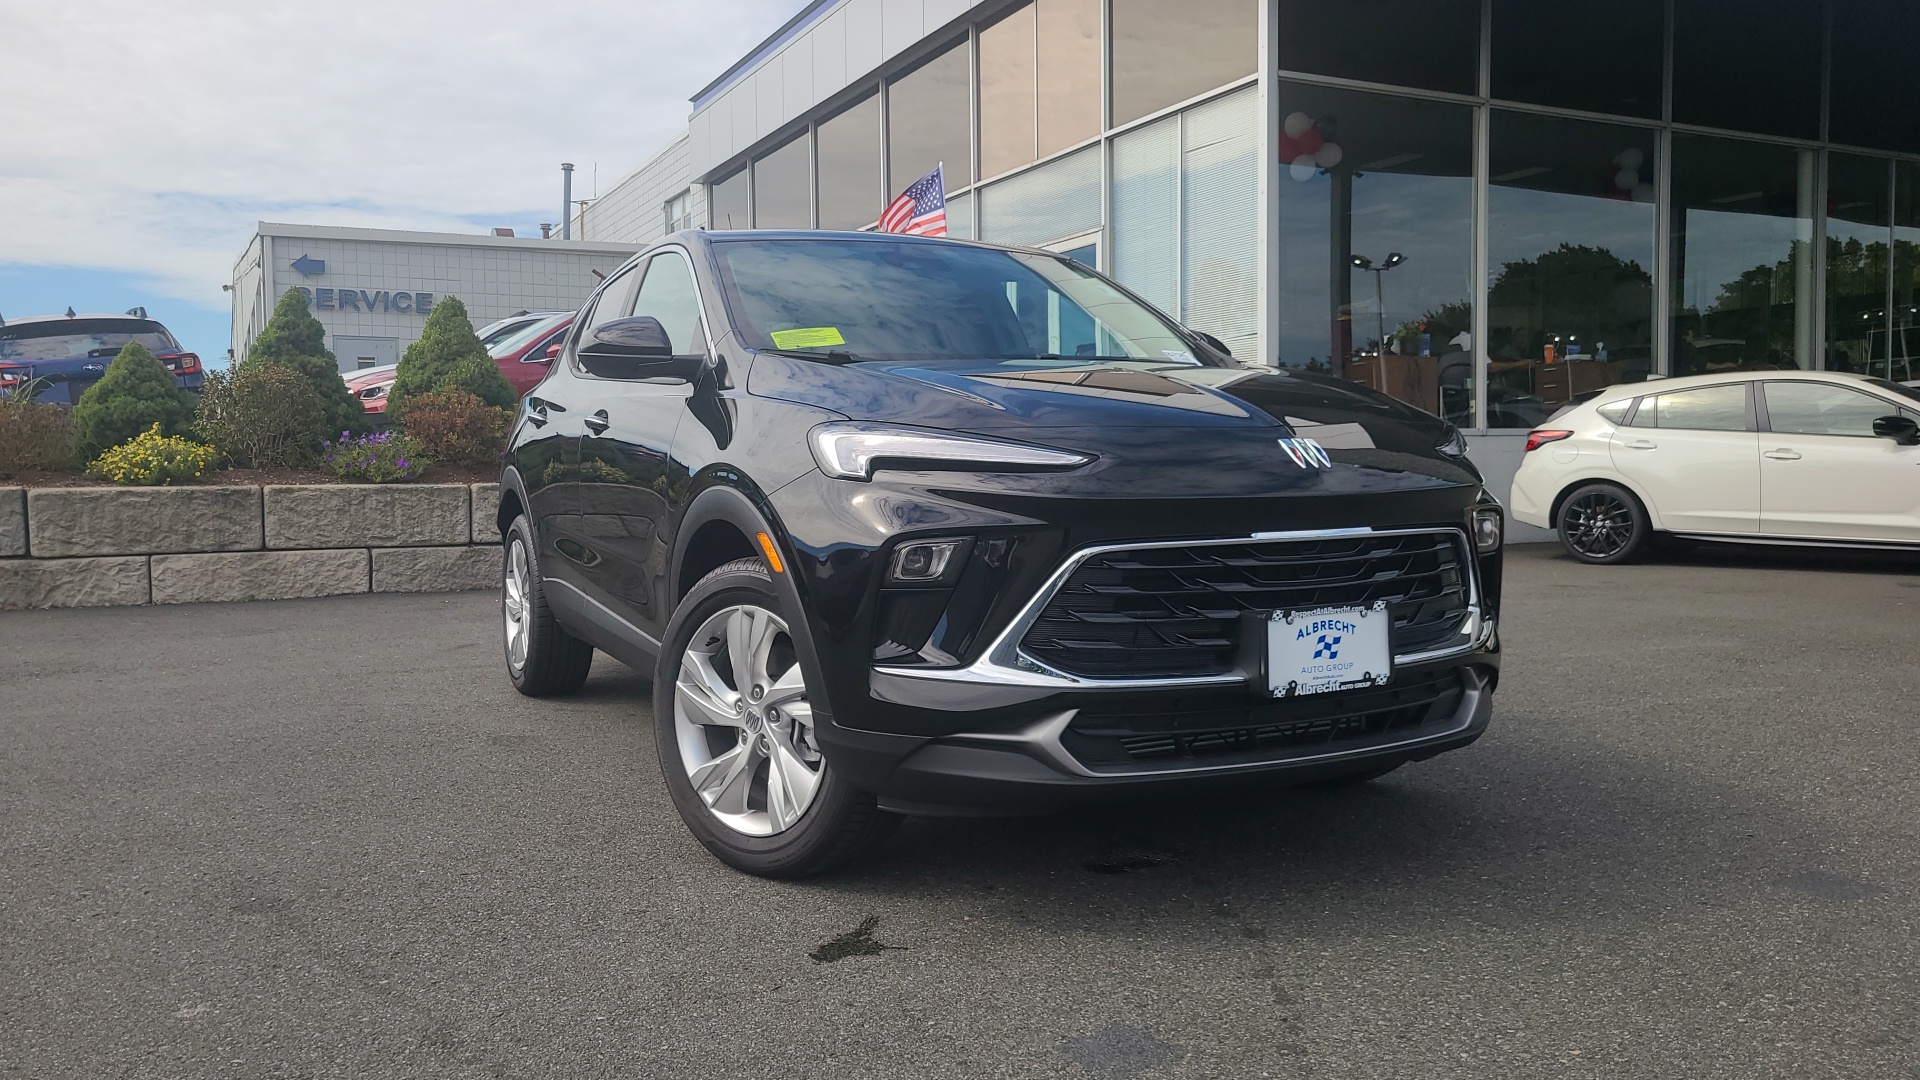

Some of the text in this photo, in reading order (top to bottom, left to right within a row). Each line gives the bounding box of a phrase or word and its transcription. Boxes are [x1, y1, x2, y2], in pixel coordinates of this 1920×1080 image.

[1297, 620, 1356, 640] ALBRECHT
[1301, 662, 1354, 674] AUTO GROUP
[1294, 680, 1341, 696] Albrecht
